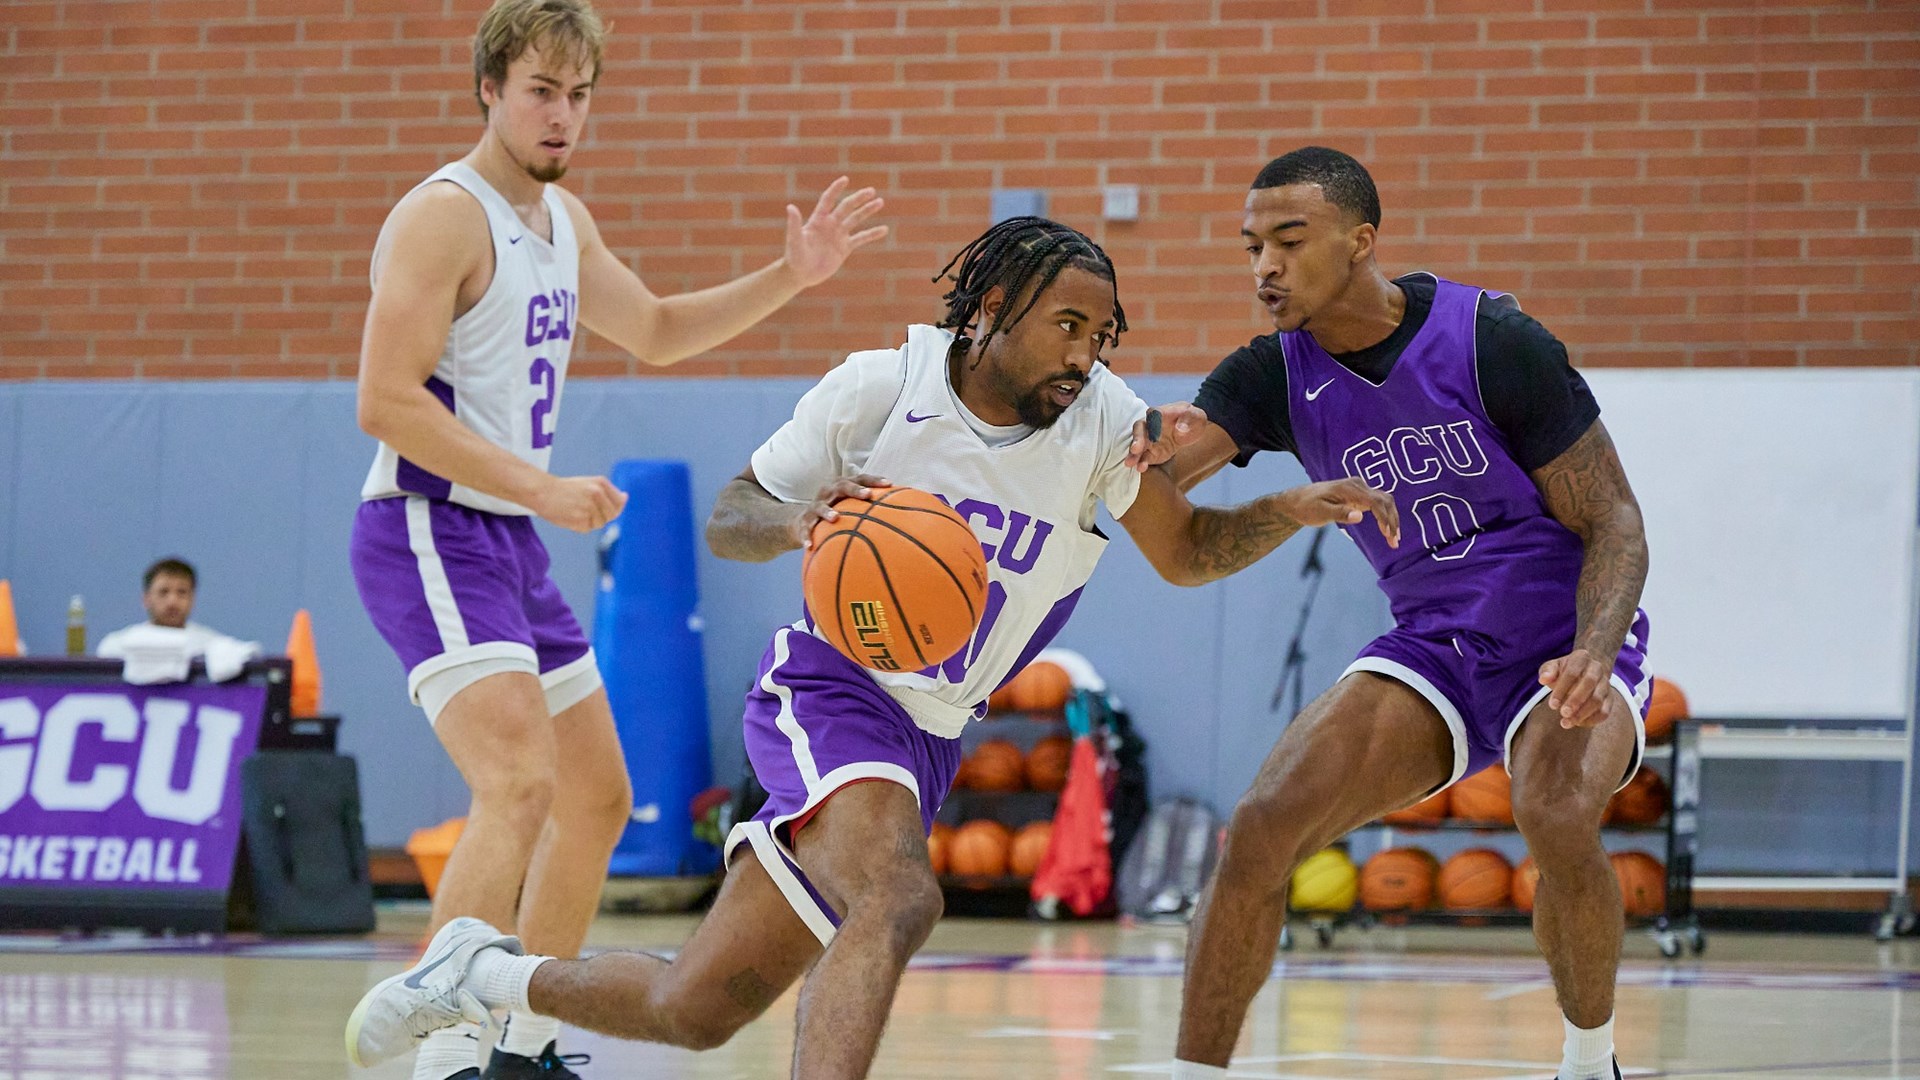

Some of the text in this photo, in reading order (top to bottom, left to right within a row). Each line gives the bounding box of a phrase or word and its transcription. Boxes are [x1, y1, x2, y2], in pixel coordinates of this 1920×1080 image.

[529, 358, 556, 450] 2
[1342, 420, 1490, 494] GCU
[932, 494, 1054, 575] CU
[1411, 492, 1482, 562] 0
[849, 601, 902, 671] ELITE
